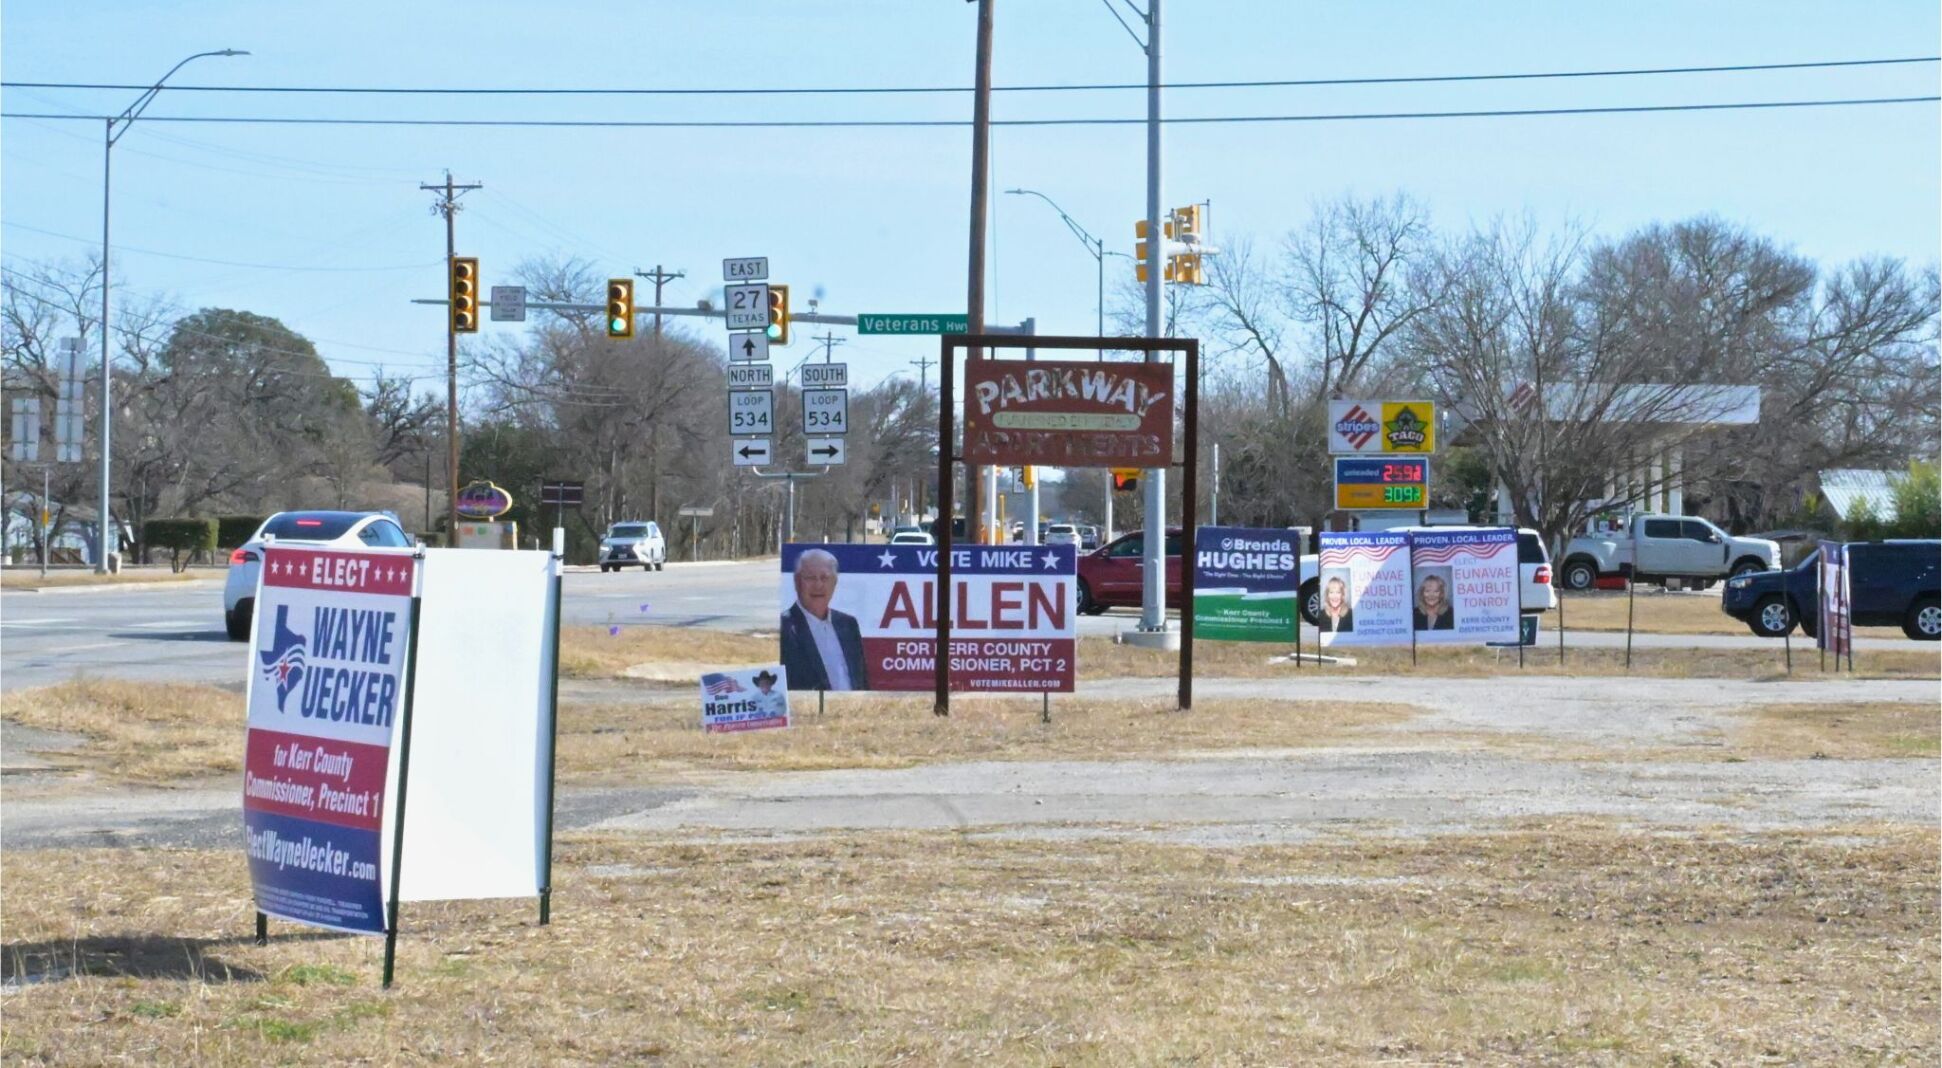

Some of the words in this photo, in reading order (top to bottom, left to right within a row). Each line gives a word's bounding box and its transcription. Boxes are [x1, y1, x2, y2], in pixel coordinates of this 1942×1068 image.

[730, 262, 762, 276] EAST
[734, 291, 760, 309] 27
[732, 313, 764, 323] TEXAS
[864, 317, 940, 331] Veterans
[730, 370, 770, 382] NORTH
[805, 369, 844, 382] SOUTH
[974, 367, 1166, 417] PARKWAY
[737, 396, 764, 406] LOOP
[812, 395, 838, 405] LOOP
[734, 412, 768, 427] 534
[808, 411, 842, 426] 534
[1337, 420, 1379, 433] stripes
[1234, 538, 1290, 552] Brenda
[1322, 537, 1349, 545] PROVEN.
[1350, 537, 1372, 545] LOCAL.
[1376, 537, 1406, 545] LEADER.
[1414, 537, 1449, 545] PROVEN.
[1452, 535, 1479, 544] LOCAL.
[1482, 534, 1514, 542] LEADER.
[981, 551, 1033, 568] MIKE
[1198, 551, 1295, 570] HUGHES
[312, 556, 370, 587] ELECT
[1455, 567, 1512, 579] EUNAVAE
[1355, 585, 1404, 597] BAUBLIT
[1457, 582, 1512, 594] BAUBLIT
[879, 581, 1066, 630] ALLEN
[1360, 599, 1402, 609] TONROY
[1464, 597, 1509, 608] TONROY
[1242, 609, 1270, 617] County
[1461, 616, 1480, 624] KERR
[1481, 616, 1510, 624] COUNTY
[1377, 618, 1403, 626] COUNTY
[312, 606, 396, 665] WAYNE
[896, 642, 930, 656] FOR
[934, 642, 978, 656] ERR
[984, 642, 1052, 656] COUNTY
[882, 657, 1015, 673] COMMSIONER,
[1020, 658, 1051, 671] PCT
[1056, 658, 1066, 671] 2
[970, 680, 1061, 688] VOTEMIKEALLEN.COM
[301, 665, 396, 728] UECKER
[705, 700, 757, 716] Harris
[273, 744, 287, 767] for
[288, 743, 312, 771] Kerr
[314, 746, 353, 782] County
[246, 770, 315, 812] Commissioner,
[318, 782, 369, 817] Precinct
[372, 792, 380, 818] 1
[246, 825, 376, 880] ElectWayneUecker.com
